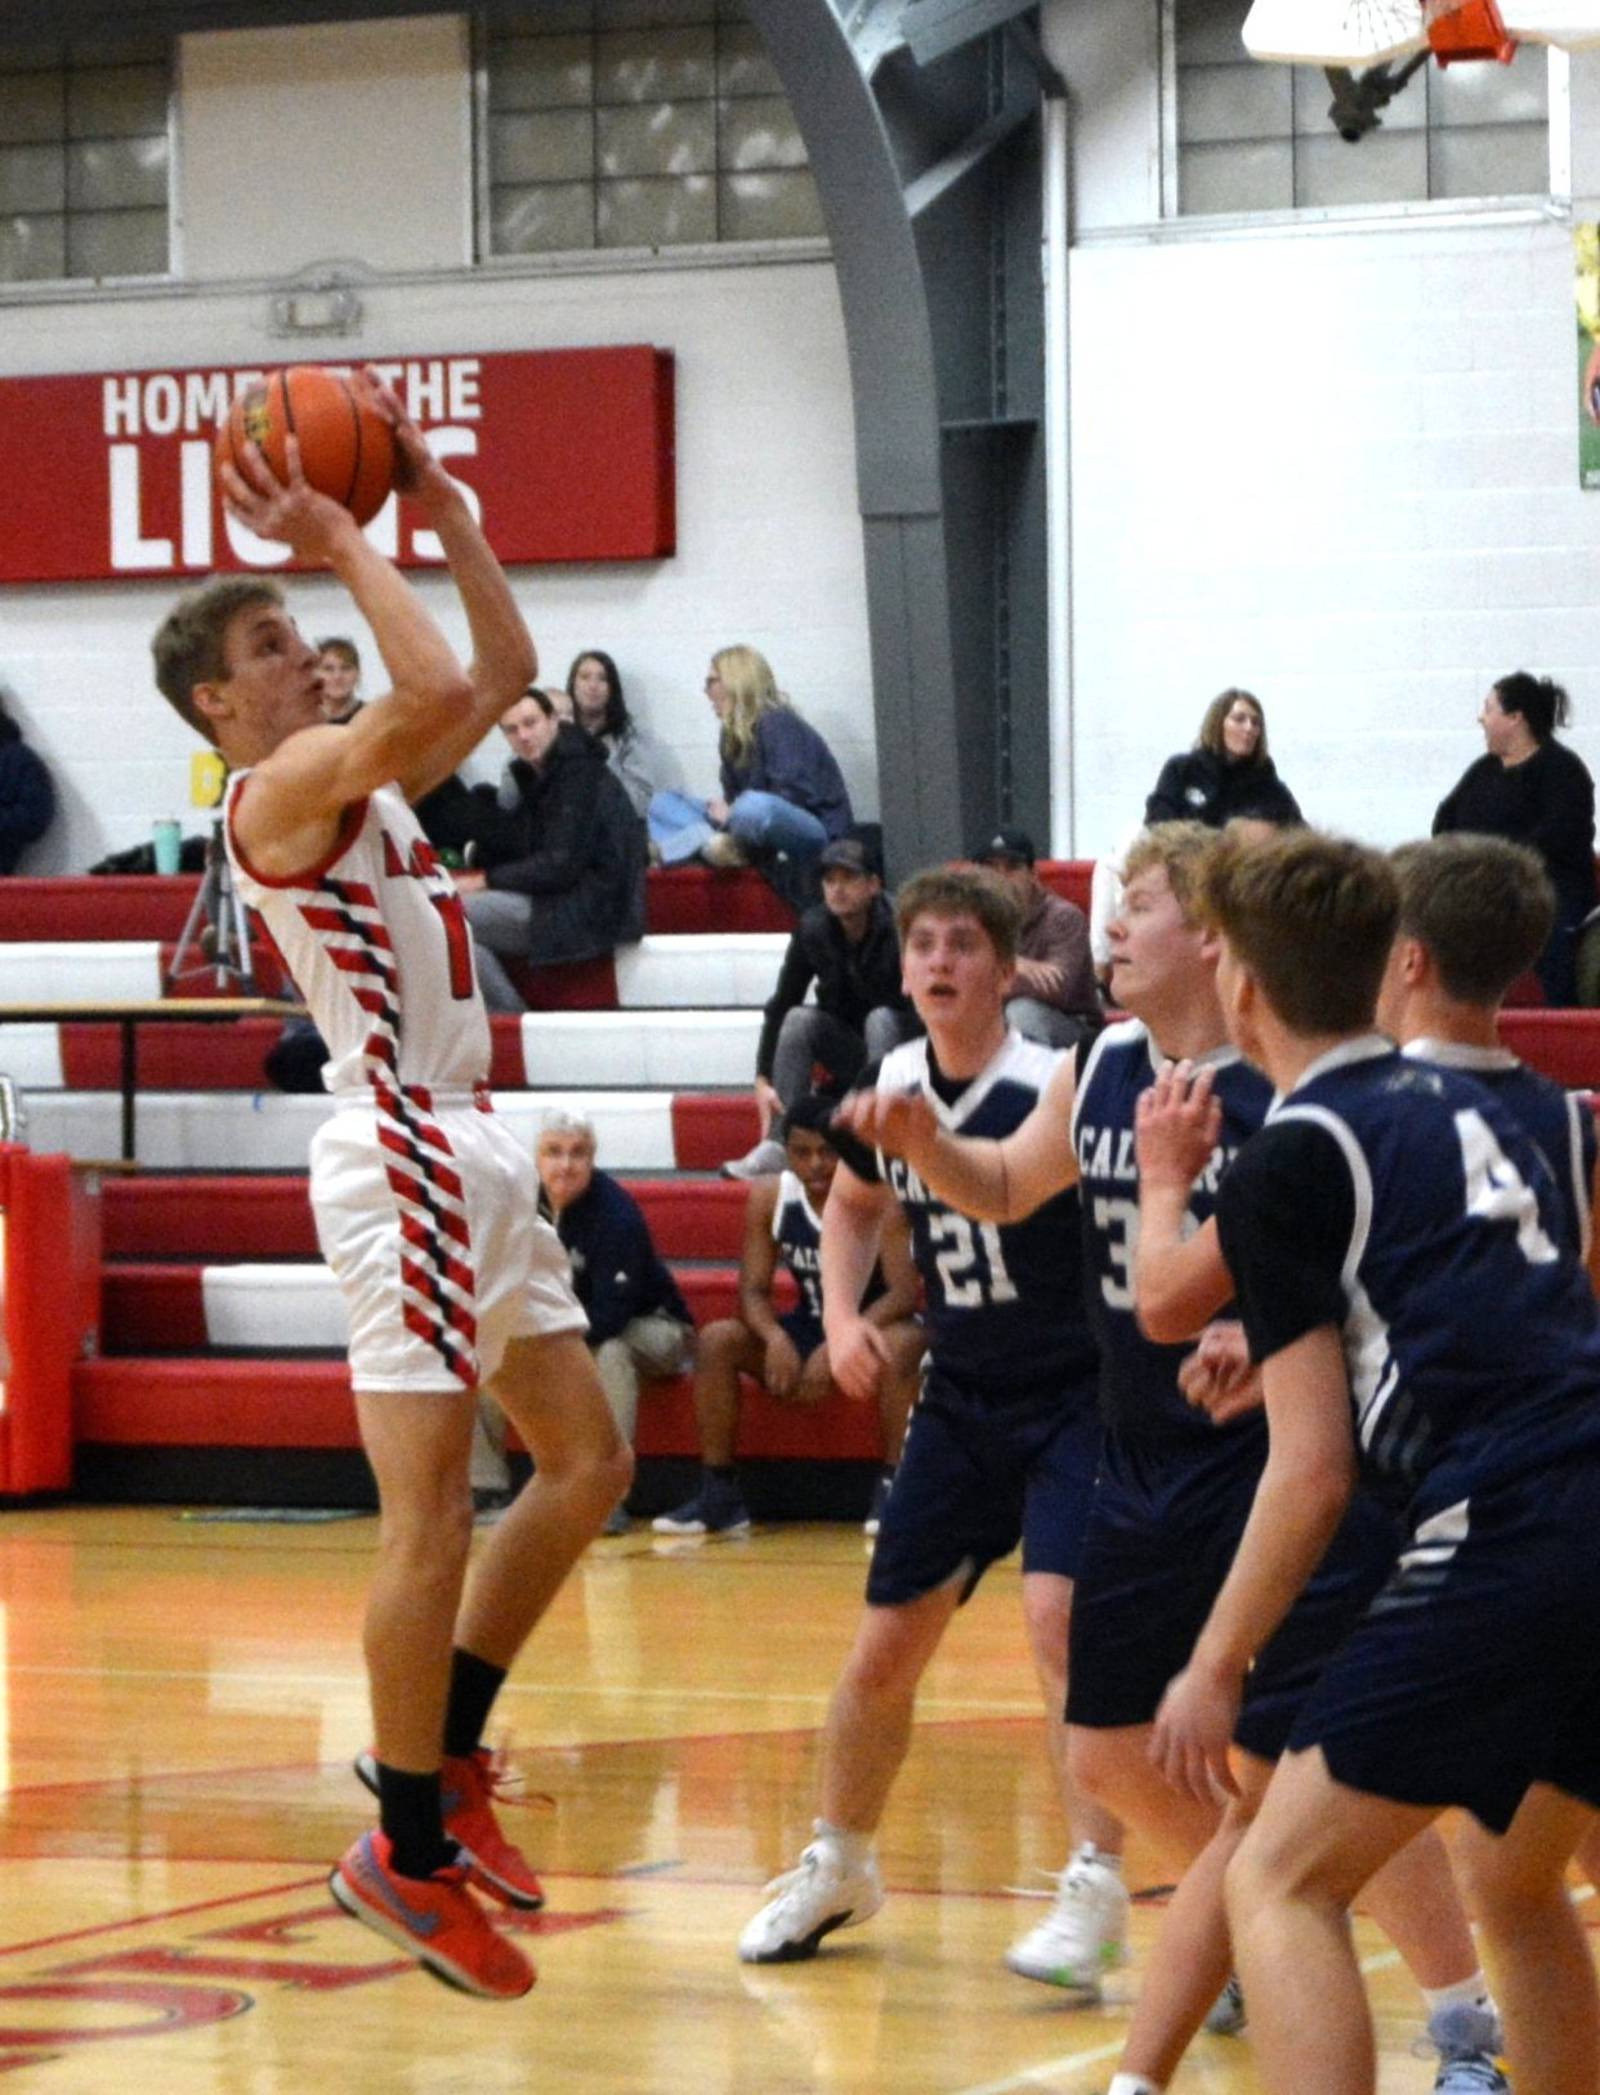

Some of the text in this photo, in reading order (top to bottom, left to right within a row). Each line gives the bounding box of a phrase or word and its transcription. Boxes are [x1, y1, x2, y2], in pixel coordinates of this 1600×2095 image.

[108, 425, 481, 569] LIS
[1454, 1107, 1560, 1263] 4
[929, 1211, 1019, 1308] 21
